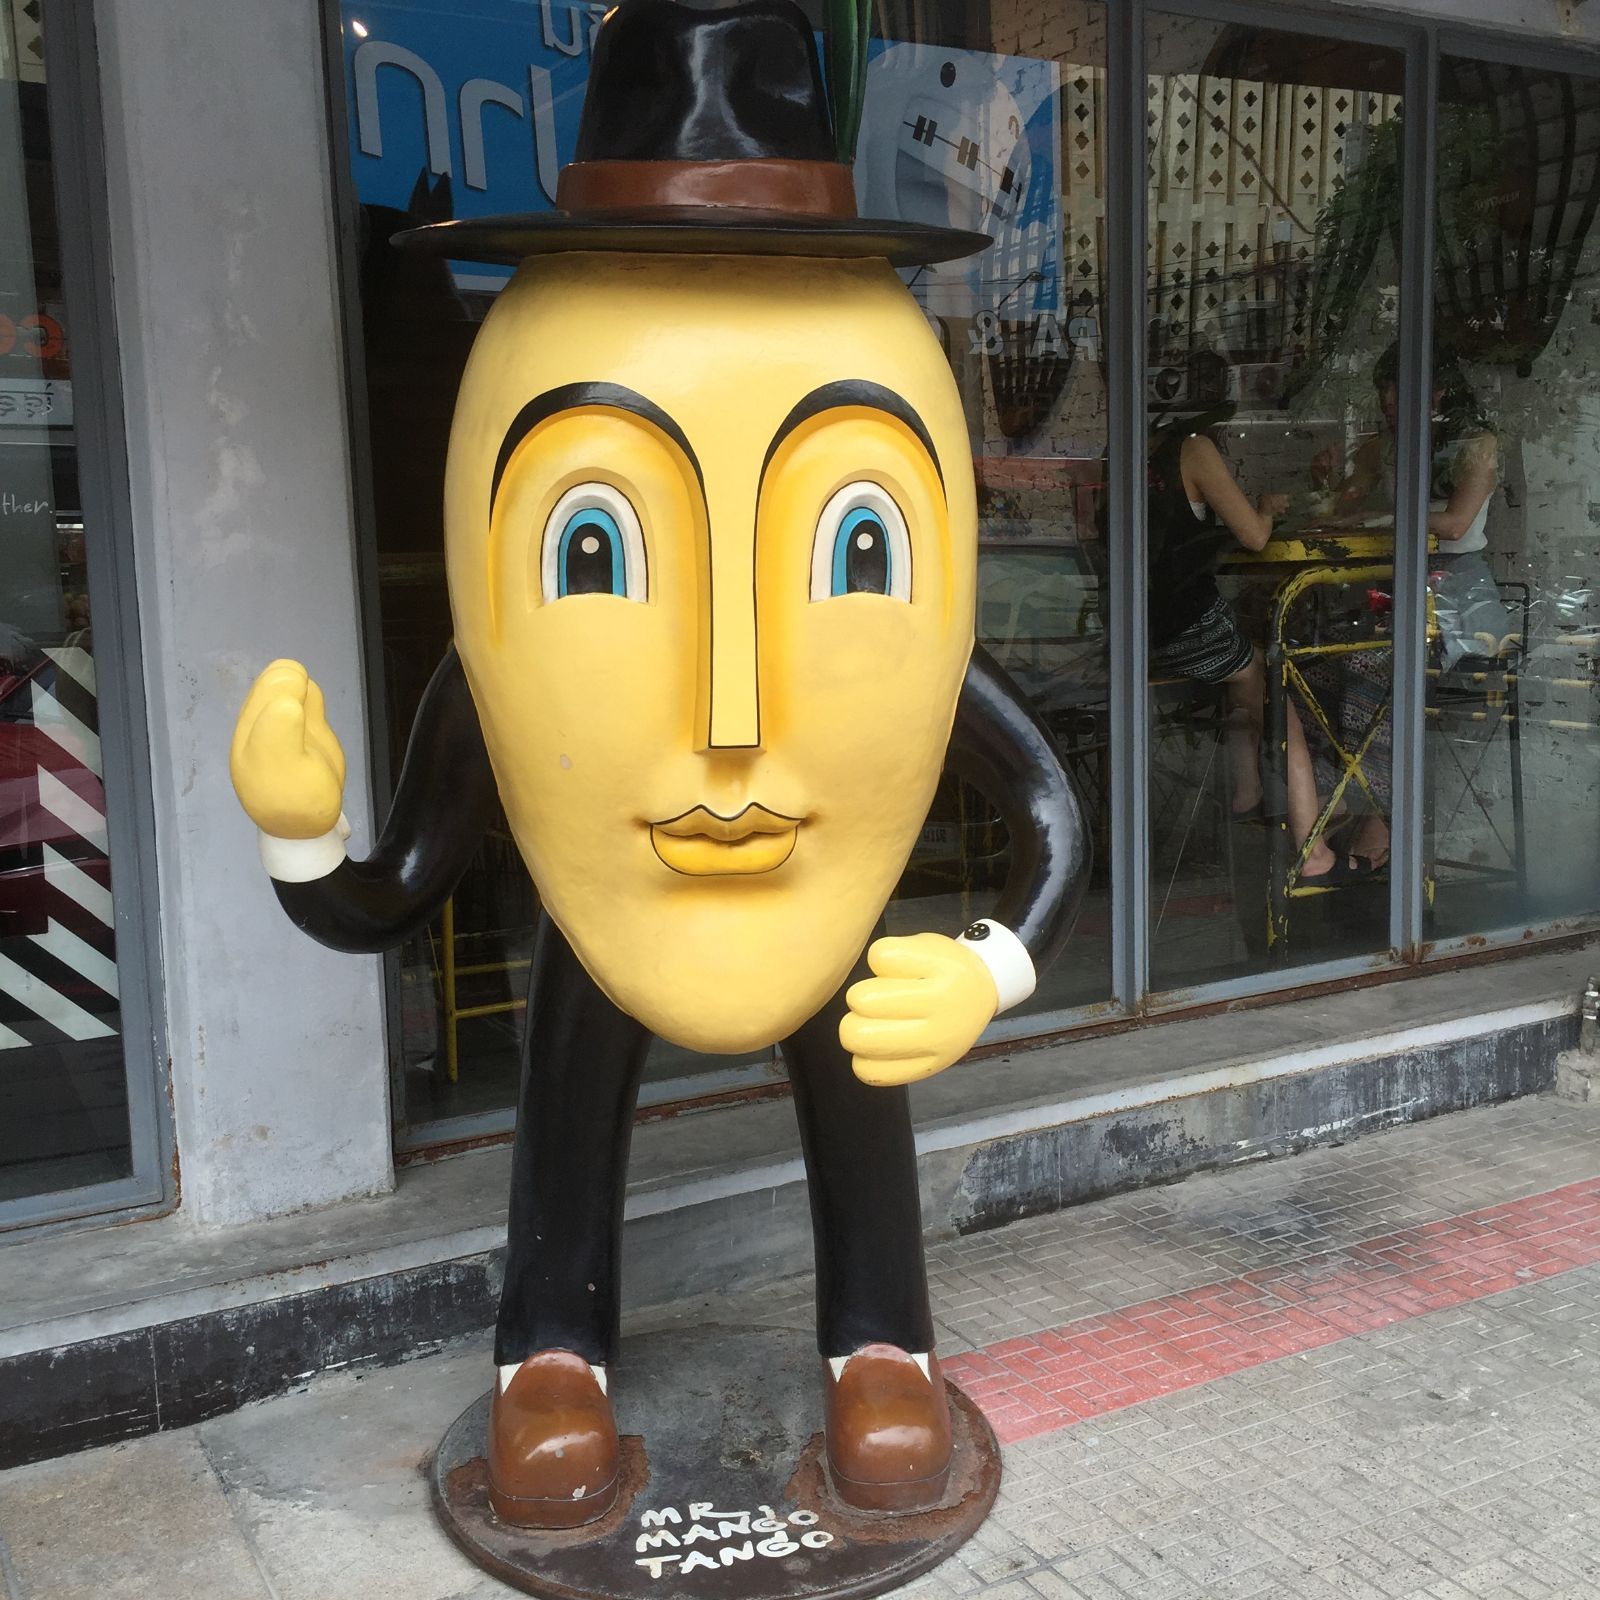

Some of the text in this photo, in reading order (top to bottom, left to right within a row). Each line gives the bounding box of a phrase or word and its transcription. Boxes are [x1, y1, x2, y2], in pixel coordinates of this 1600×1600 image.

[636, 1504, 820, 1553] MANGO
[641, 1502, 751, 1528] MR
[635, 1530, 834, 1579] TANGO
